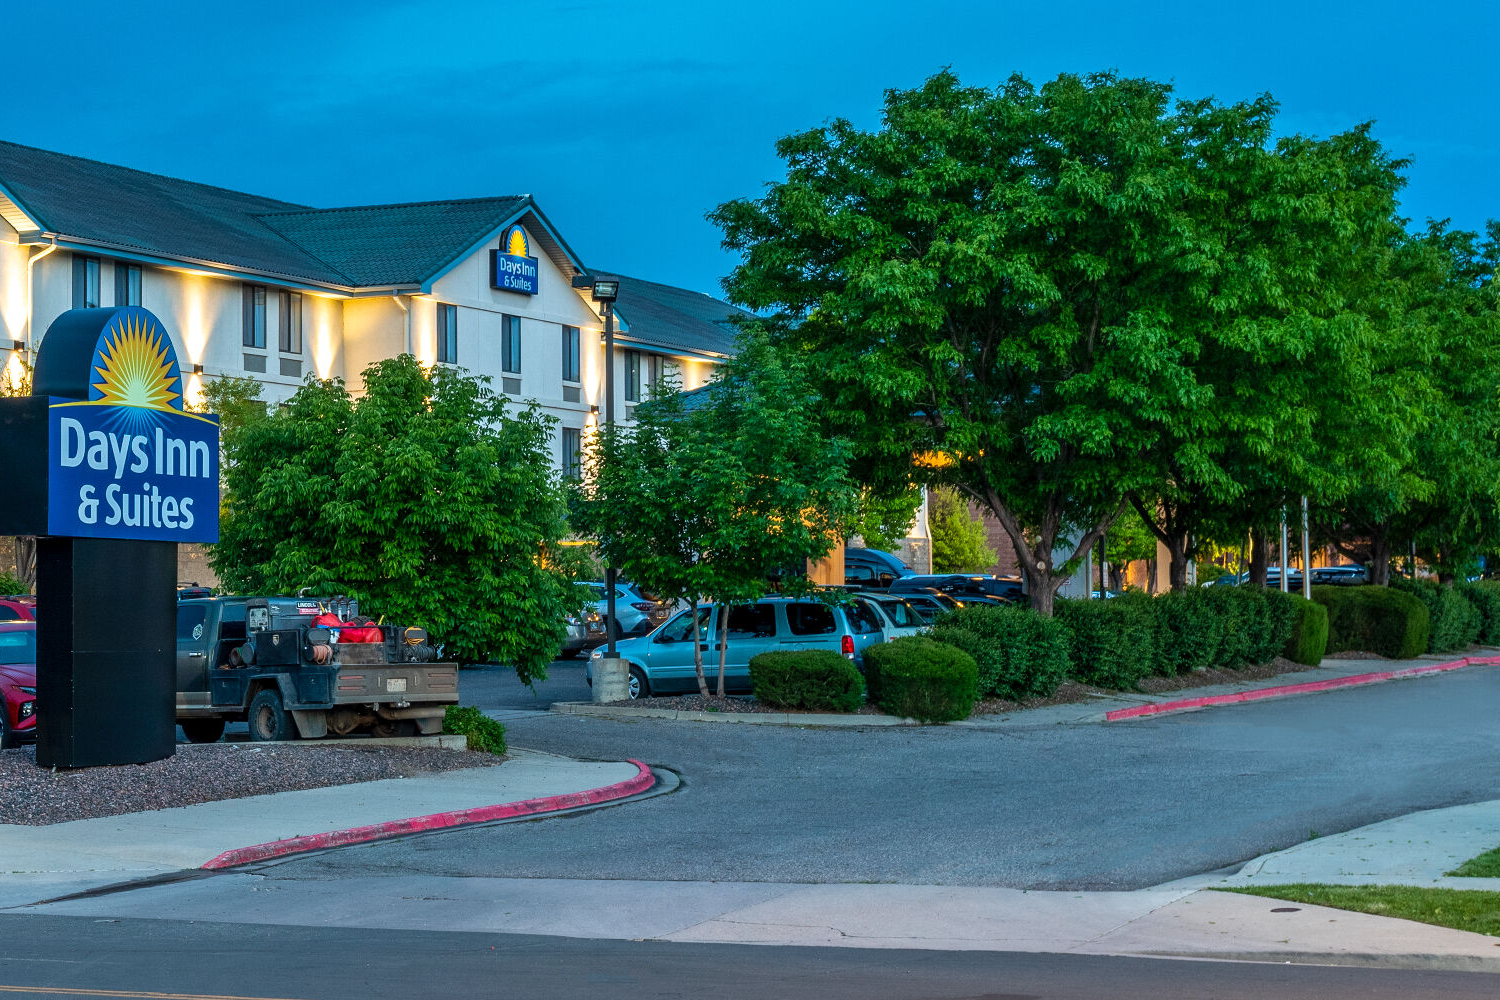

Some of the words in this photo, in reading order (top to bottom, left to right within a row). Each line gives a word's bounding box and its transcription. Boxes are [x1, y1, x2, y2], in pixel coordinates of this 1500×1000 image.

[500, 257, 521, 275] Days
[522, 262, 535, 277] Inn
[504, 275, 510, 287] &
[510, 275, 532, 291] Suites
[60, 416, 149, 480] Days
[155, 427, 210, 479] Inn
[78, 484, 100, 524] &
[105, 482, 195, 529] Suites
